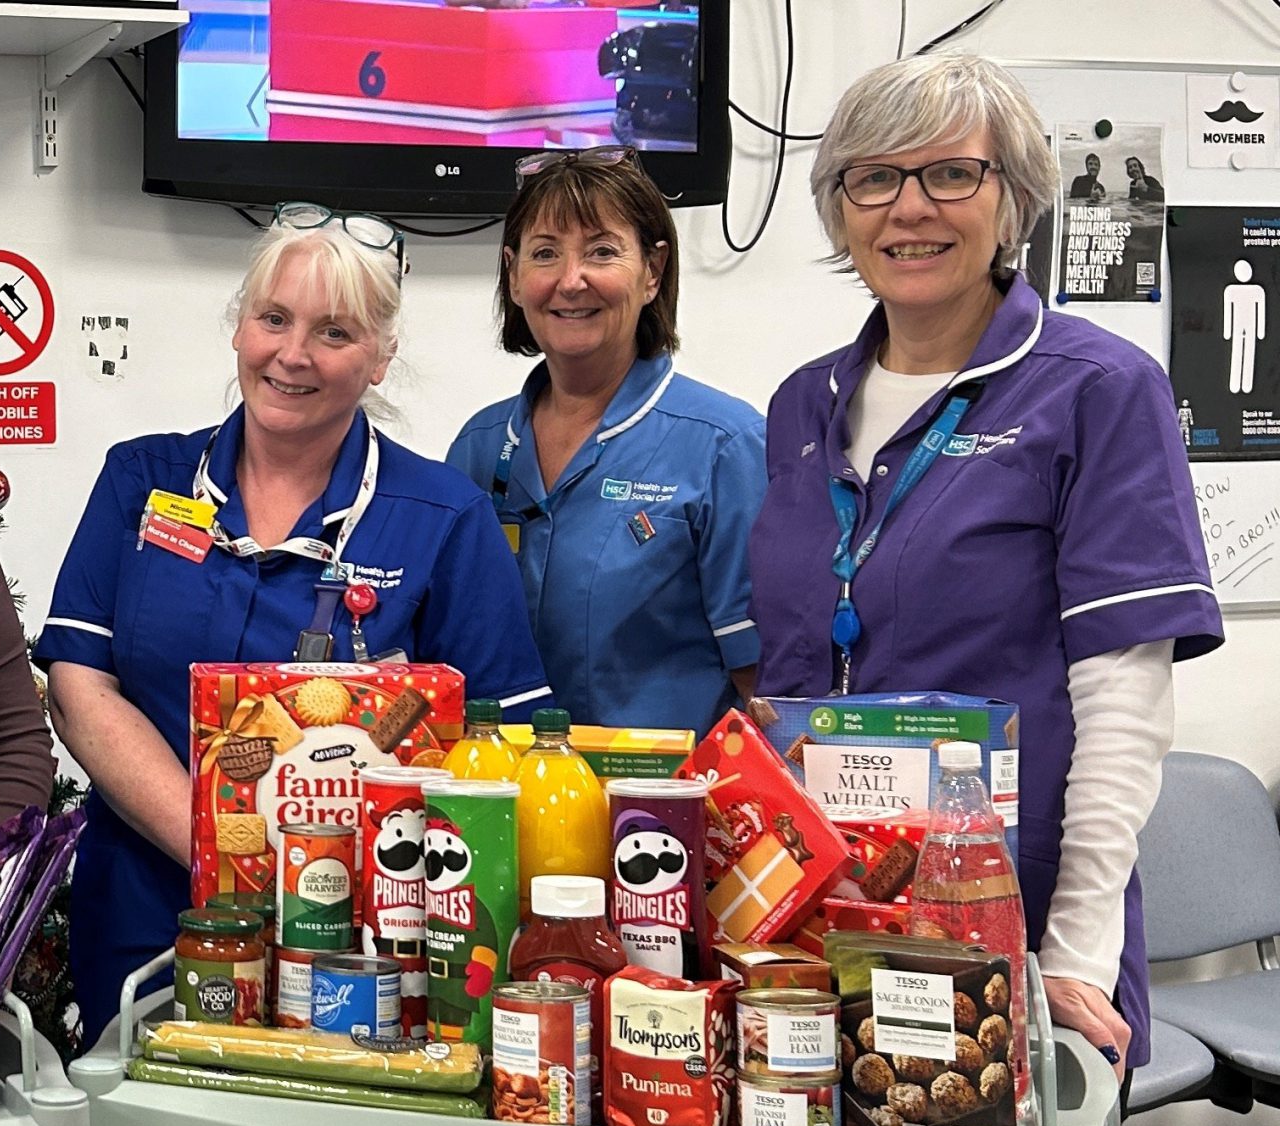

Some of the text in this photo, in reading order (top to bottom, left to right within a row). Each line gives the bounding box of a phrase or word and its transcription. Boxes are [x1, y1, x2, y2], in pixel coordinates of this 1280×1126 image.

[358, 50, 387, 98] 6
[1202, 132, 1266, 145] MOVEMBER
[447, 165, 461, 175] LG
[1070, 206, 1112, 221] RAISING
[1069, 221, 1132, 237] AWARENESS
[1069, 236, 1126, 251] AND FUNDS
[1067, 250, 1124, 265] FOR MEN'S
[1066, 264, 1109, 280] MENTAL
[1065, 279, 1105, 295] HEALTH
[10, 386, 40, 400] OFF
[501, 440, 513, 461] NHS
[949, 438, 971, 451] HSC
[606, 484, 626, 495] HSC
[633, 481, 678, 493] Health and
[631, 492, 654, 502] Social
[1202, 507, 1211, 523] A
[146, 524, 206, 556] Nurse in Charge
[1226, 545, 1237, 560] A
[355, 564, 405, 579] Health and
[380, 578, 402, 589] Care
[840, 753, 893, 767] TESCO
[275, 763, 361, 798] fami
[837, 772, 898, 792] MALT
[822, 791, 911, 809] WHEATS
[276, 800, 363, 827] Circl
[305, 883, 347, 894] HARVEST
[373, 872, 425, 907] PRINGL
[614, 888, 688, 926] PRINGLES
[434, 931, 465, 944] CREAM
[622, 932, 677, 946] TEXAS BBQ
[635, 943, 662, 952] SAUCE
[894, 976, 929, 987] TESCO
[203, 991, 233, 1002] FOOD
[875, 992, 903, 1004] SAGE
[914, 996, 950, 1008] ONION
[789, 1020, 821, 1029] TESCO
[614, 1014, 702, 1056] Thompson's
[788, 1034, 821, 1044] DANISH
[789, 1043, 821, 1055] HAM
[621, 1072, 693, 1097] Punjana
[754, 1095, 785, 1104] TESCO
[650, 1109, 662, 1122] 40
[754, 1109, 787, 1120] DANISH
